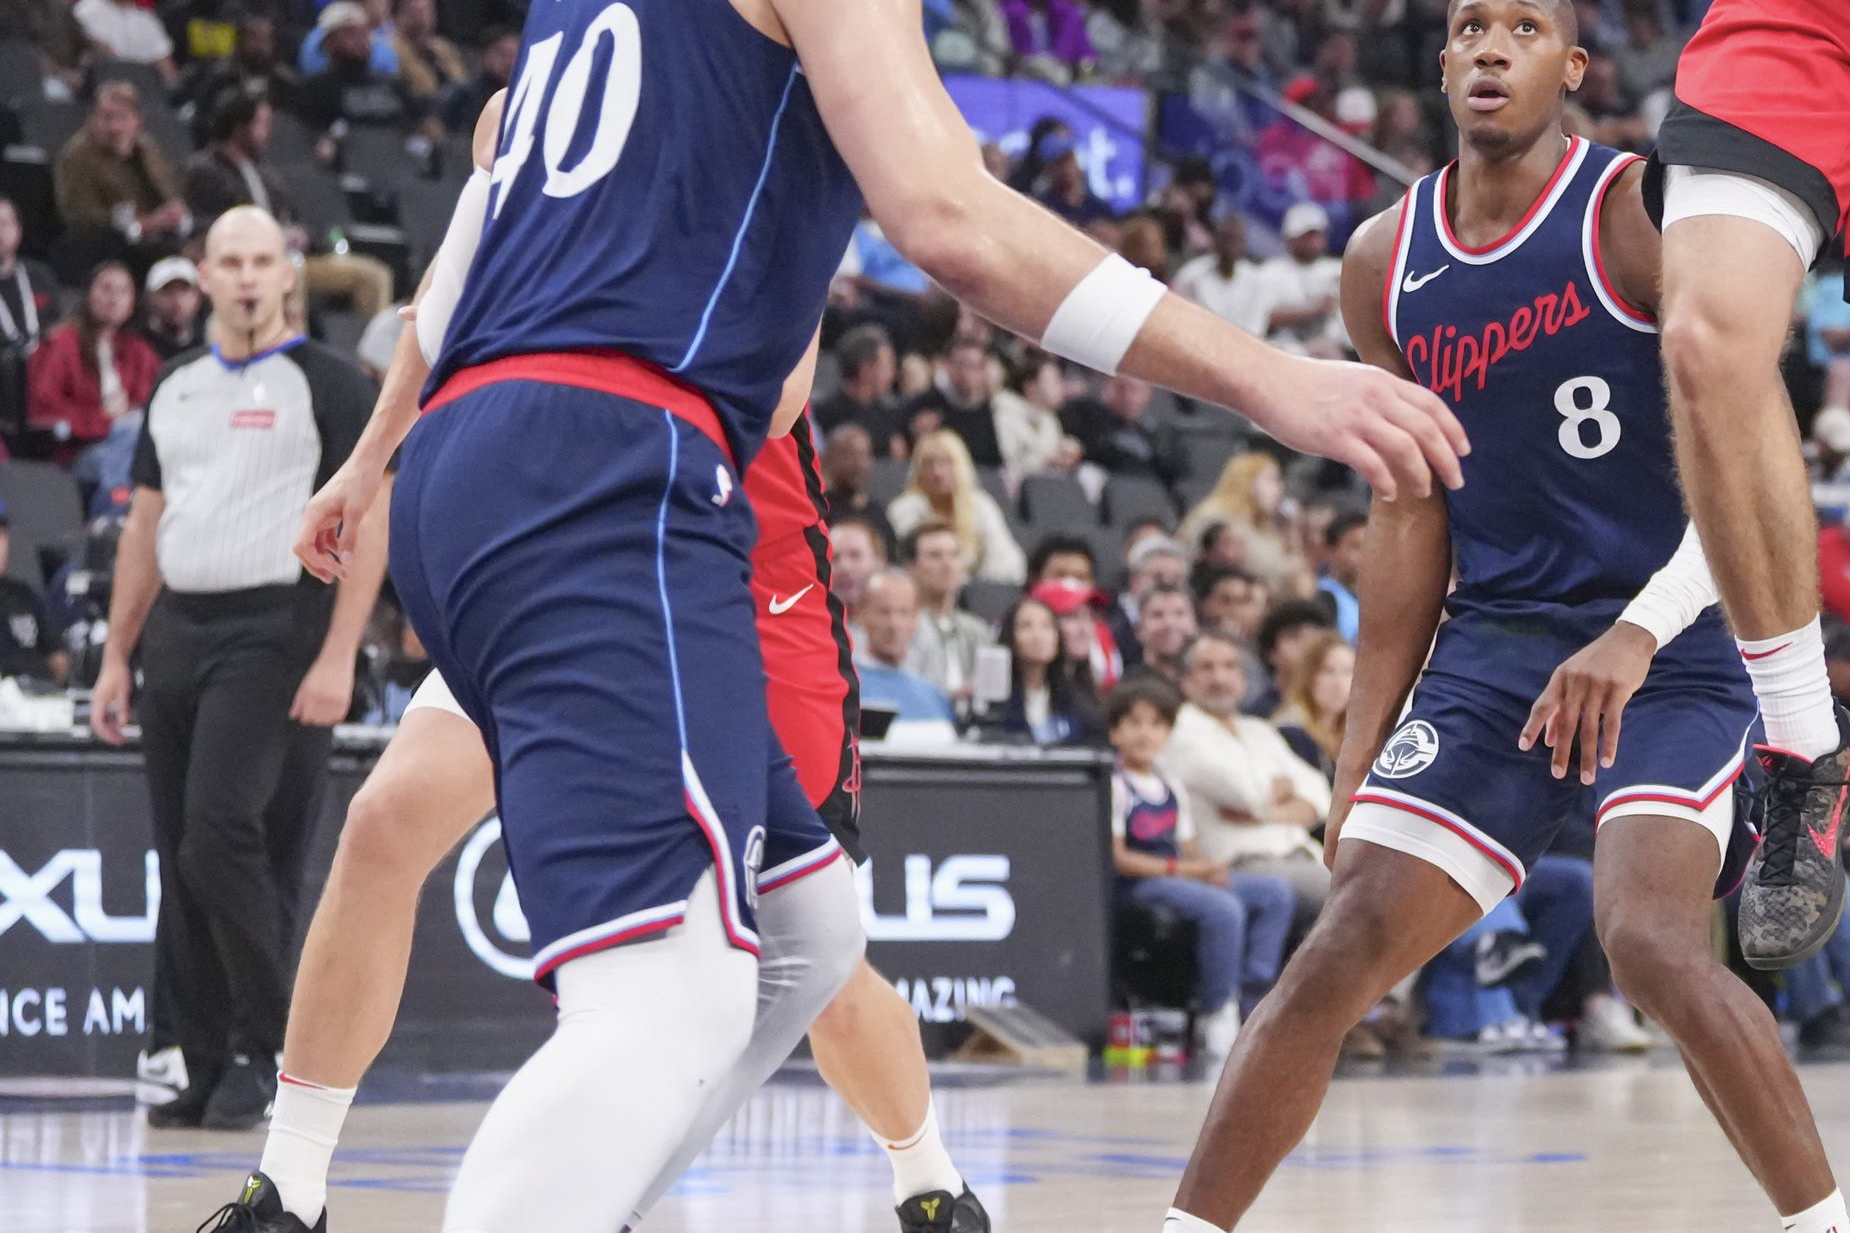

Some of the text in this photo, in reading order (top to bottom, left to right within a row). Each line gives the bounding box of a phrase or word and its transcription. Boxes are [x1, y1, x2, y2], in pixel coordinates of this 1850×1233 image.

[491, 2, 642, 221] 40
[1406, 281, 1590, 403] Clippers
[1554, 375, 1621, 459] 8
[83, 986, 153, 1035] AM
